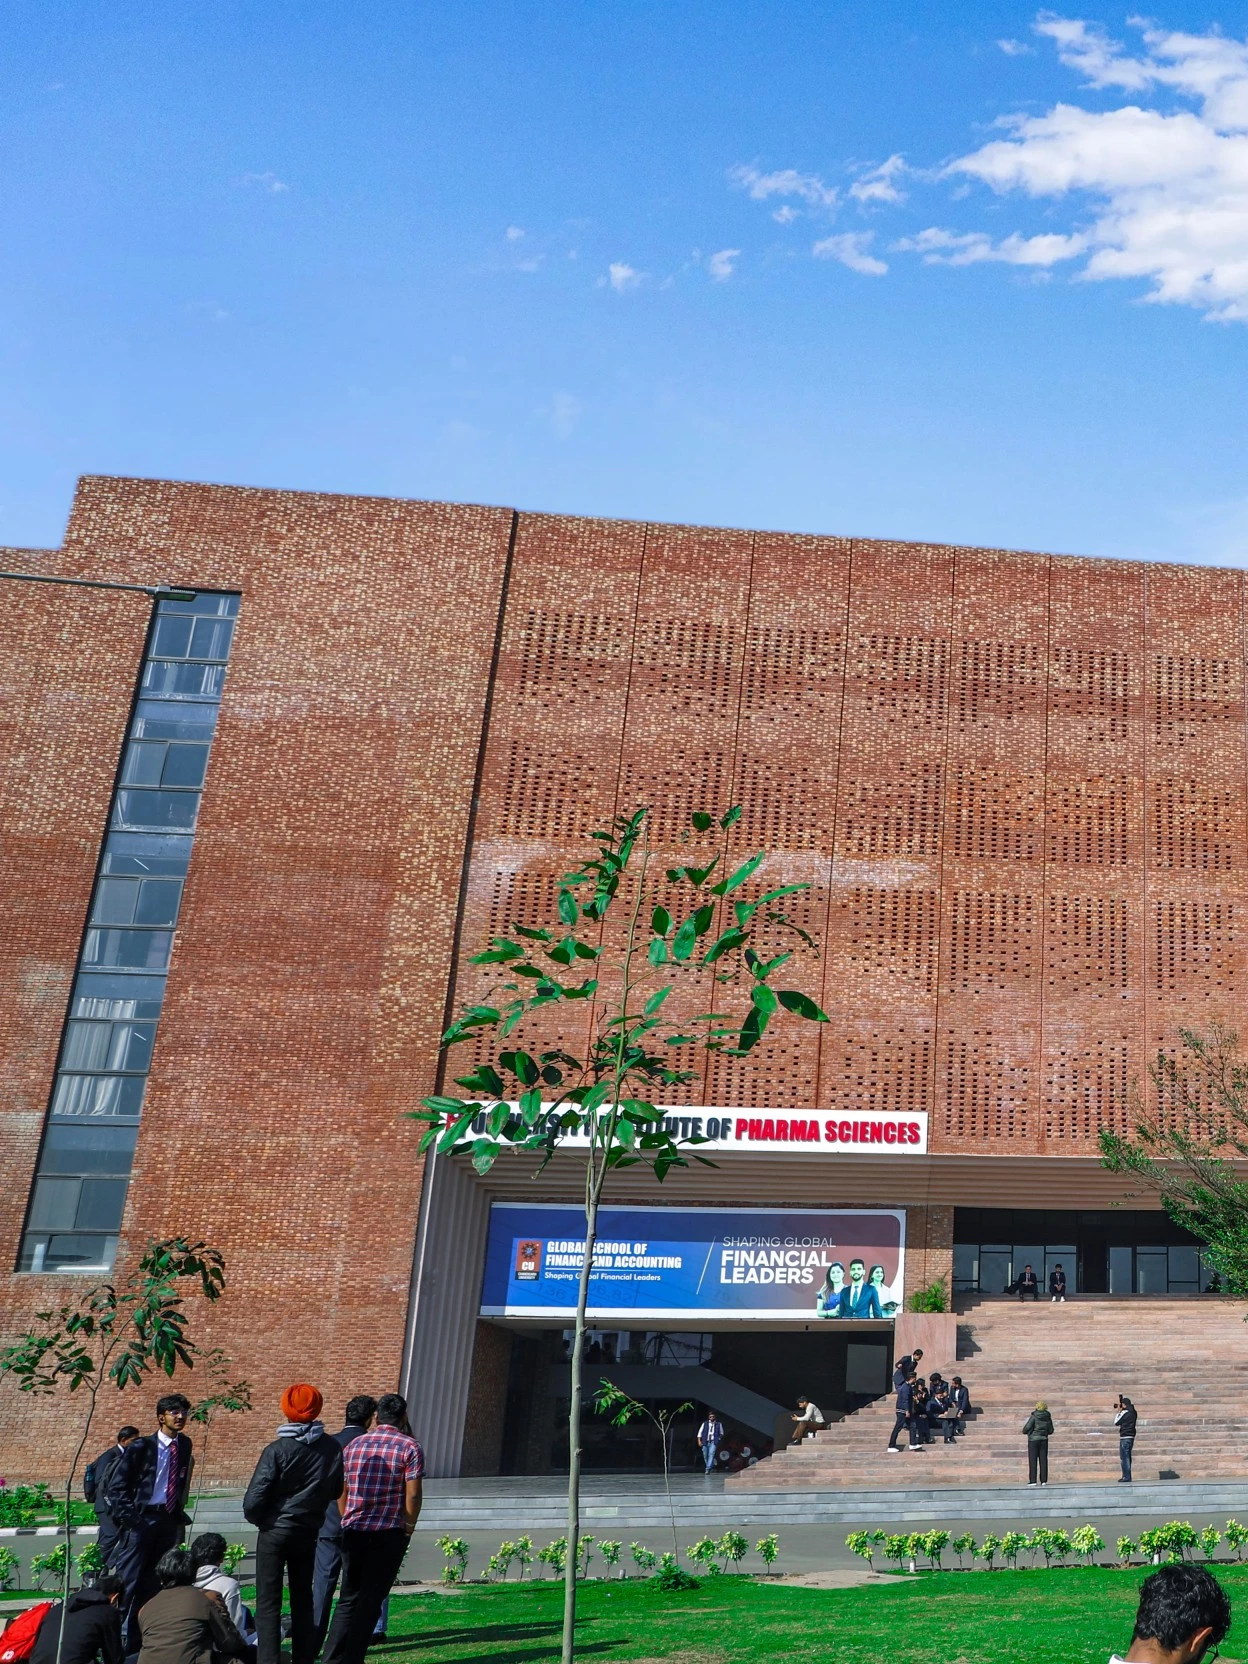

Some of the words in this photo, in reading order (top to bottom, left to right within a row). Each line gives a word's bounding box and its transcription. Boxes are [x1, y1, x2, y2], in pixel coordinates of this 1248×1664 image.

[706, 1117, 732, 1140] OF
[735, 1118, 821, 1143] PHARMA
[824, 1120, 921, 1145] SCIENCES
[722, 1236, 781, 1247] SHAPING
[784, 1237, 837, 1248] GLOBAL
[633, 1243, 648, 1255] OF
[545, 1254, 584, 1267] FINANC
[614, 1255, 682, 1269] ACCOUNTING
[721, 1250, 833, 1267] FINANCIAL
[521, 1261, 535, 1271] CU
[544, 1272, 574, 1281] Shaping
[600, 1272, 633, 1281] Financial
[633, 1273, 661, 1281] Leaders
[720, 1267, 814, 1284] LEADERS
